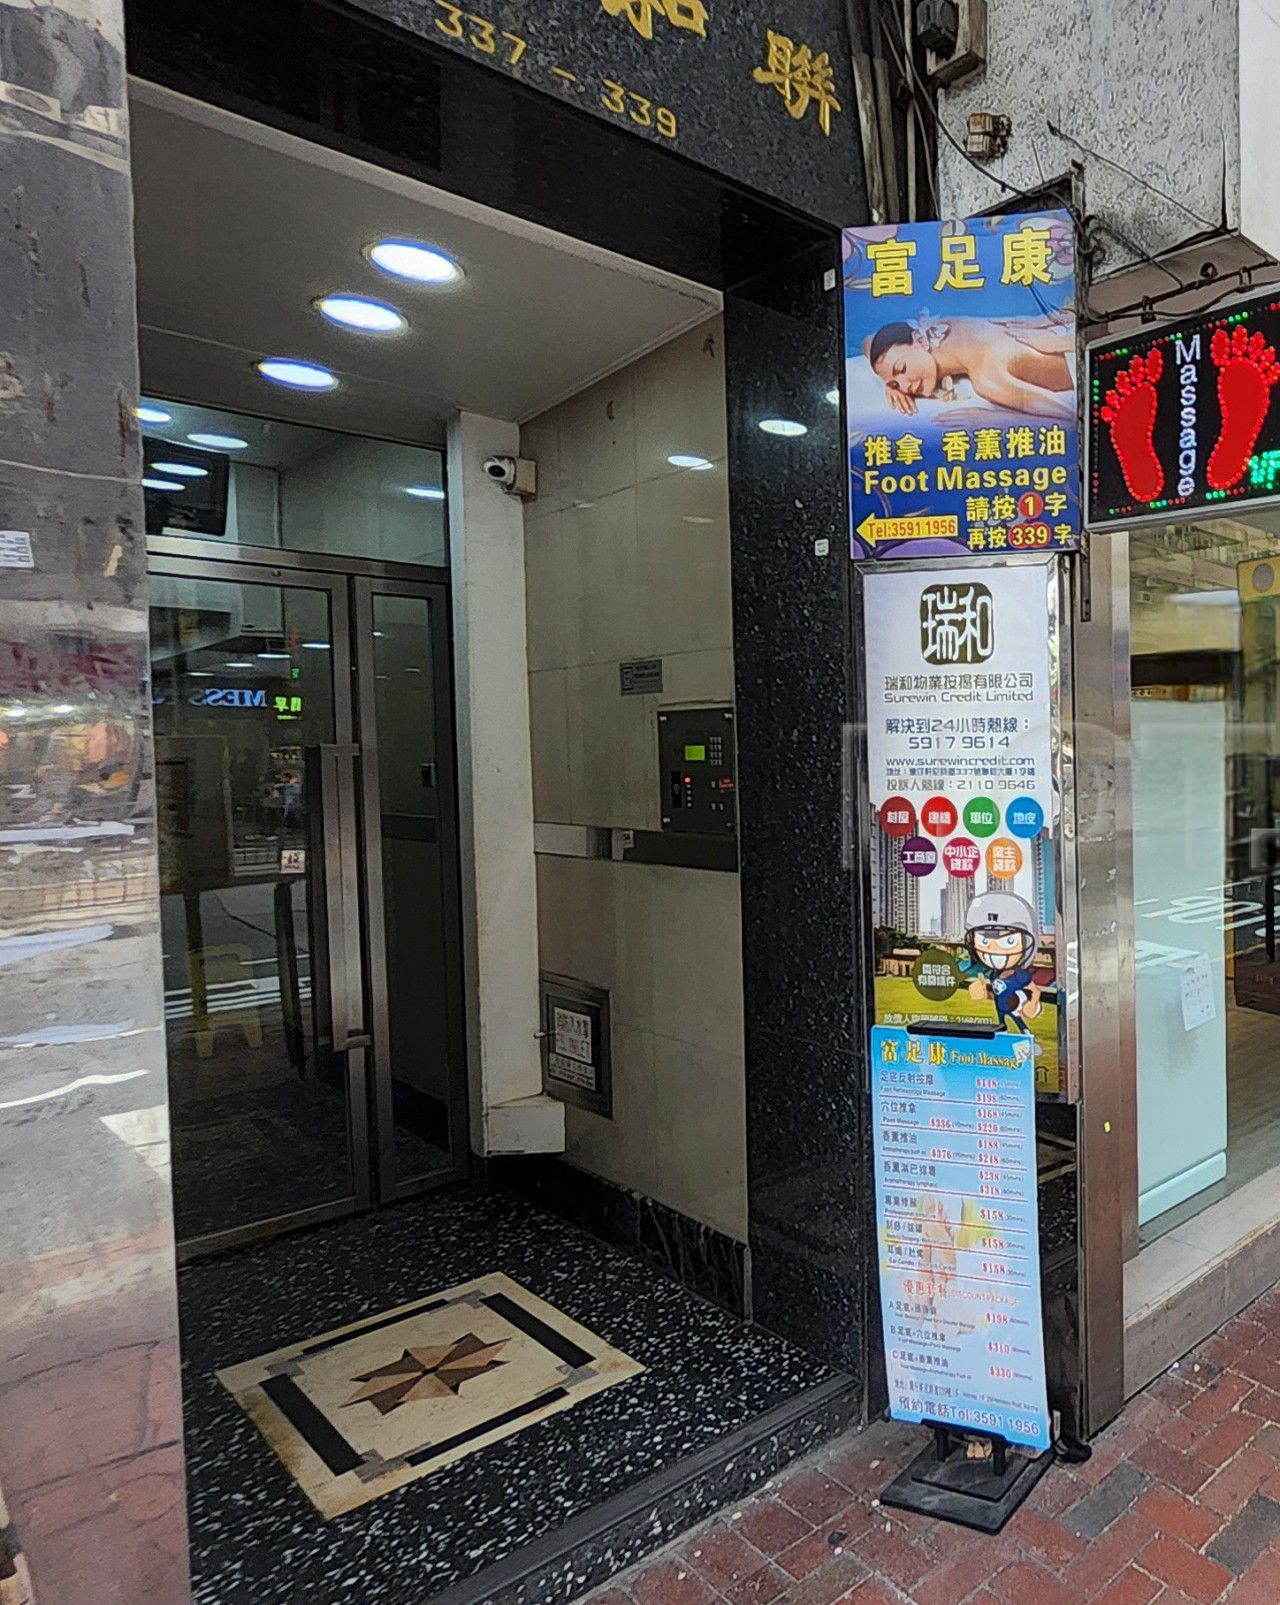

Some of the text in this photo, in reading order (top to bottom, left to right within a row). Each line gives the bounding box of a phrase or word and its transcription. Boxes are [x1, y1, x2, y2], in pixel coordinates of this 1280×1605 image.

[434, 0, 528, 65] 337
[602, 79, 677, 138] 339
[866, 227, 1055, 299] 富足康
[1175, 334, 1202, 498] Massage
[864, 427, 1067, 467] 推拿 香薰推油
[864, 463, 1068, 495] Foot Massage
[925, 520, 956, 535] 1956
[884, 691, 1034, 703] Surewin Credit Limited
[909, 736, 1010, 750] 5917 9614
[886, 755, 1035, 766] www.surewincredit.com
[957, 780, 994, 791] 2110
[998, 779, 1036, 791] 9646
[944, 846, 979, 858] 中小企
[1008, 1417, 1039, 1435] 1956
